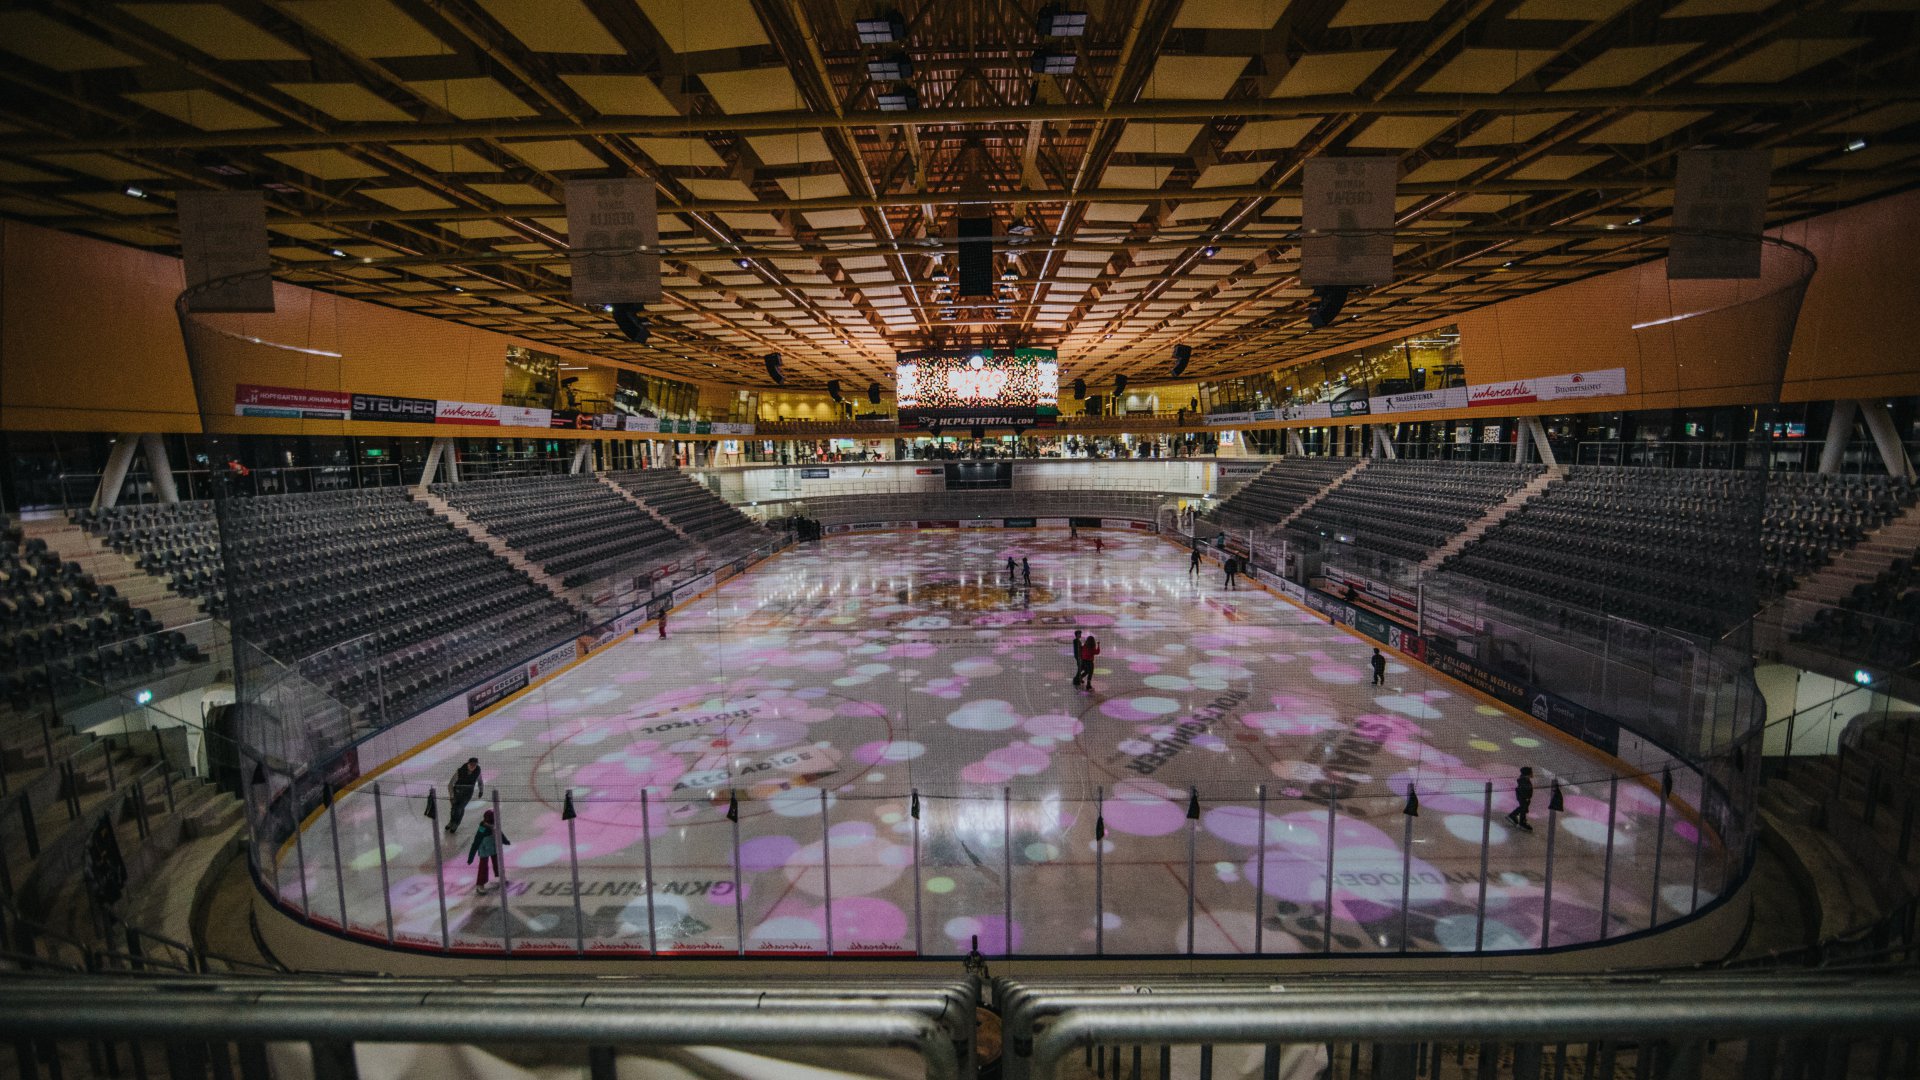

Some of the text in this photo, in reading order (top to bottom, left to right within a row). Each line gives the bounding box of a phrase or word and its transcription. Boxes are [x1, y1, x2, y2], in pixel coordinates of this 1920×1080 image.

[1472, 382, 1531, 399] intercable
[353, 396, 435, 414] STEURER
[440, 403, 496, 418] intercable
